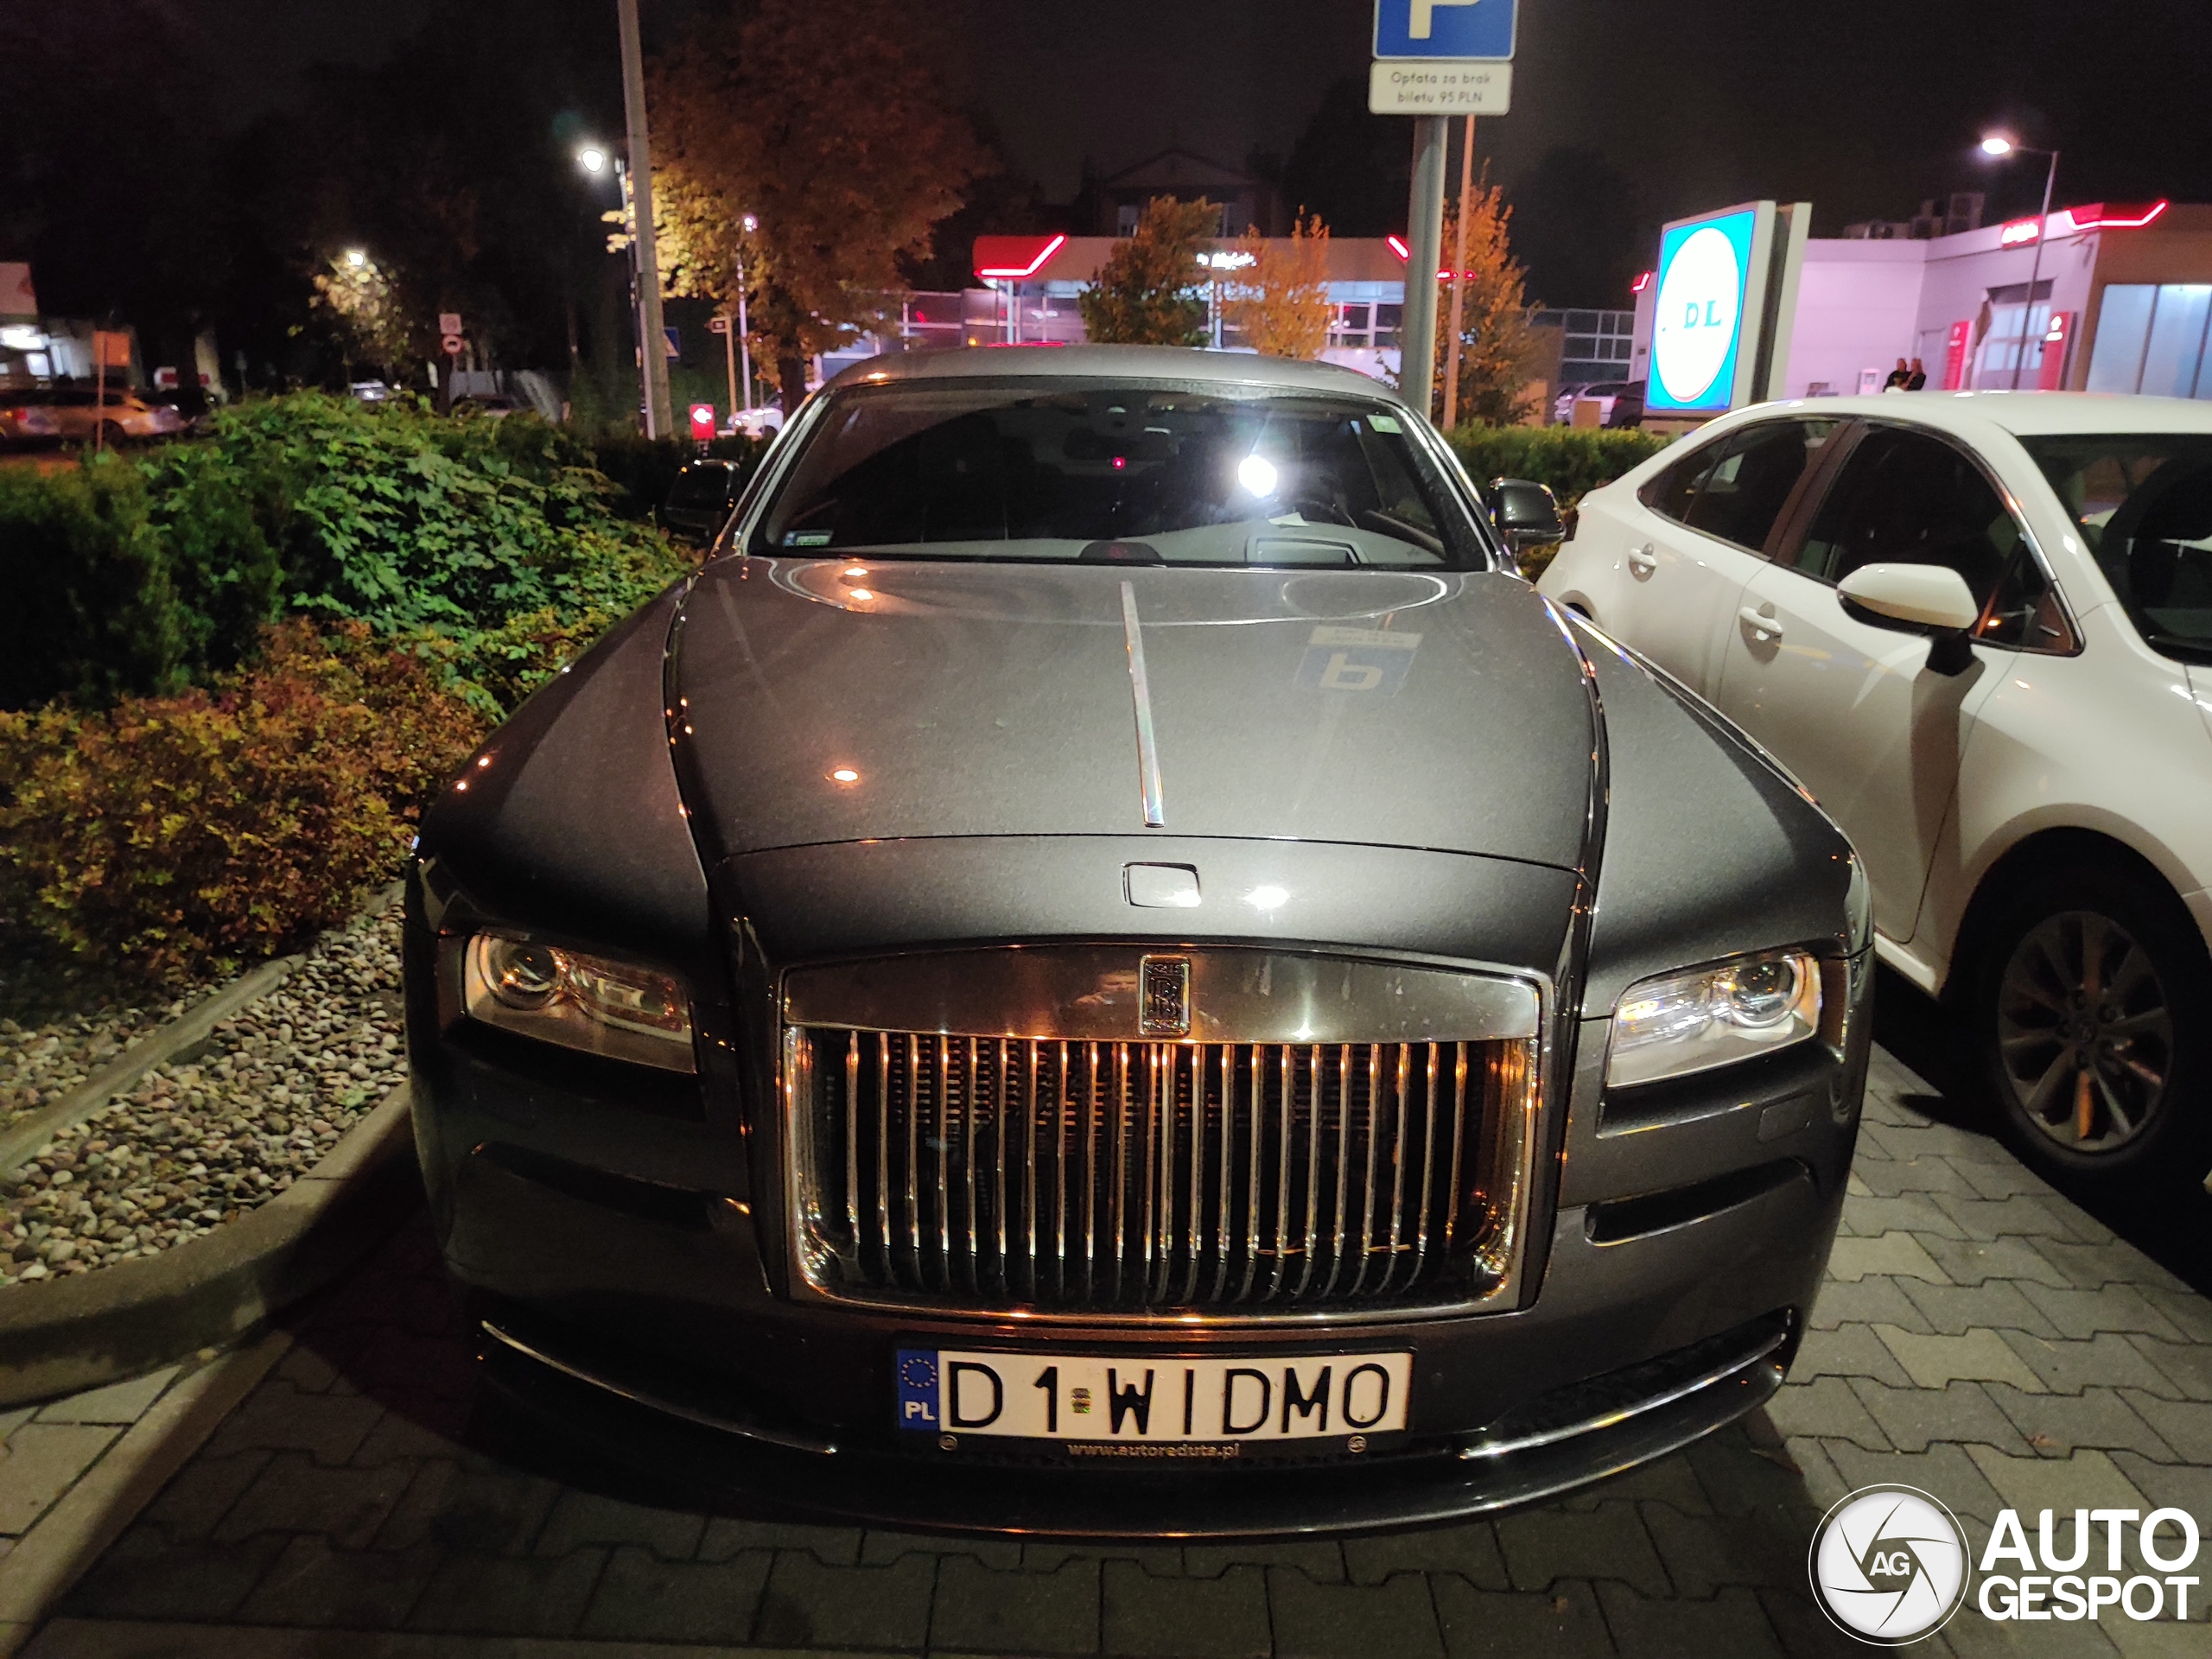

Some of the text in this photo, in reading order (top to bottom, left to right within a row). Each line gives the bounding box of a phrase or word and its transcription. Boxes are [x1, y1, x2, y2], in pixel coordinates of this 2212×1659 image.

[1443, 75, 1456, 84] za
[1462, 73, 1491, 84] brak
[1397, 92, 1483, 103] biletu 95 PLN
[1107, 1362, 1390, 1435] WIDMO
[905, 1401, 937, 1421] PL
[1066, 1442, 1241, 1460] www.autoreduta.pl
